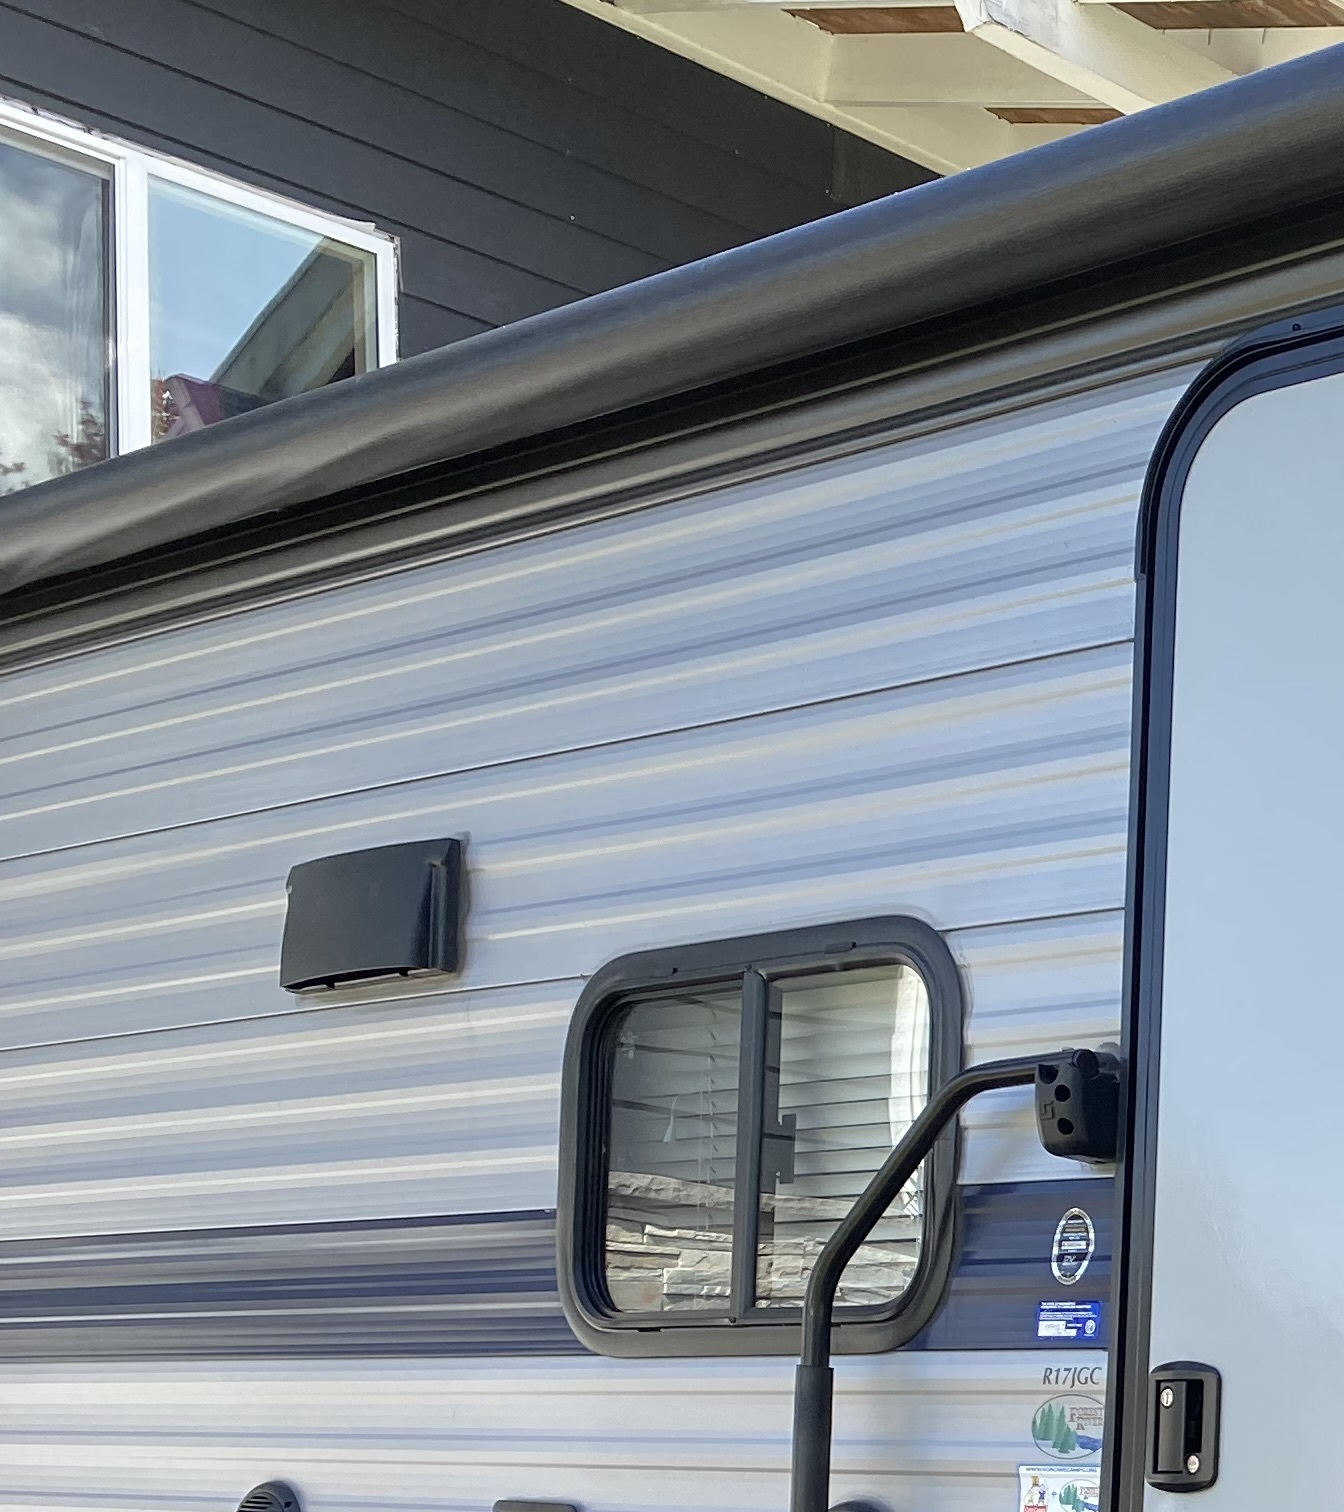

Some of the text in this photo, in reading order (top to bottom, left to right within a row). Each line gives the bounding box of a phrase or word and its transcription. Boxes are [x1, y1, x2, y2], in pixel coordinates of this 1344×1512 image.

[1042, 1366, 1102, 1388] R17JGC
[1068, 1407, 1103, 1422] FOREST
[1076, 1417, 1103, 1430] RIVER
